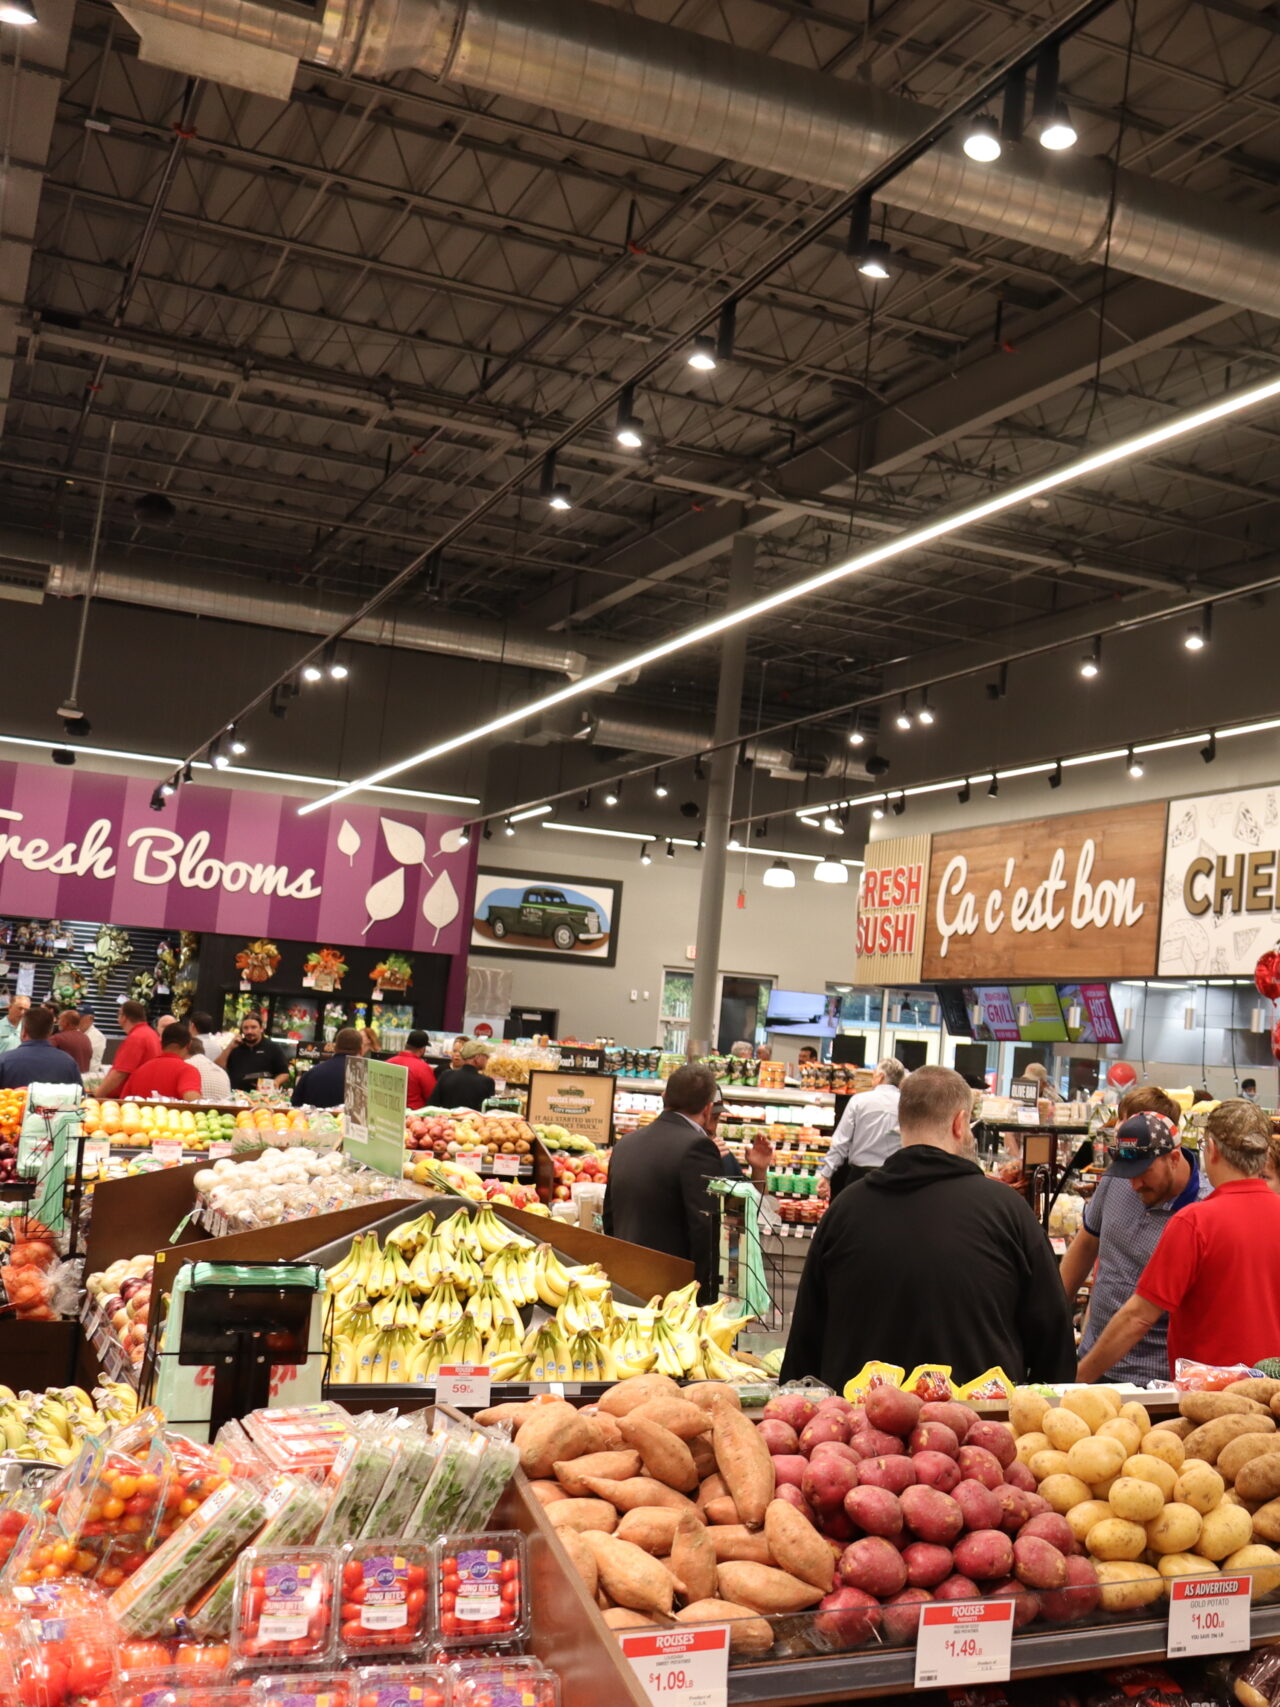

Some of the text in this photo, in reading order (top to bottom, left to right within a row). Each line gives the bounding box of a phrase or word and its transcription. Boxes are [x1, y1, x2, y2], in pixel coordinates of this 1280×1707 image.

[127, 827, 322, 899] Blooms
[859, 864, 923, 910] RESH
[936, 839, 1144, 958] Ça c'est bon
[855, 911, 917, 957] SUSHI
[986, 1004, 1016, 1023] GRILL
[1088, 999, 1109, 1017] HOT
[1094, 1018, 1116, 1039] BAR
[583, 1056, 599, 1069] Head
[1012, 1084, 1037, 1099] OLIVE BAR
[387, 1590, 406, 1600] BITES
[481, 1583, 499, 1593] BITES
[1184, 1581, 1238, 1596] AS ADVERTISED
[287, 1602, 306, 1611] BITE
[952, 1605, 985, 1617] ROUSES
[1190, 1598, 1229, 1608] GOLD POTATO
[1192, 1612, 1219, 1629] $1.00
[656, 1634, 694, 1647] ROUSES
[945, 1639, 976, 1657] $1.49
[649, 1671, 693, 1691] $1.09 LB
